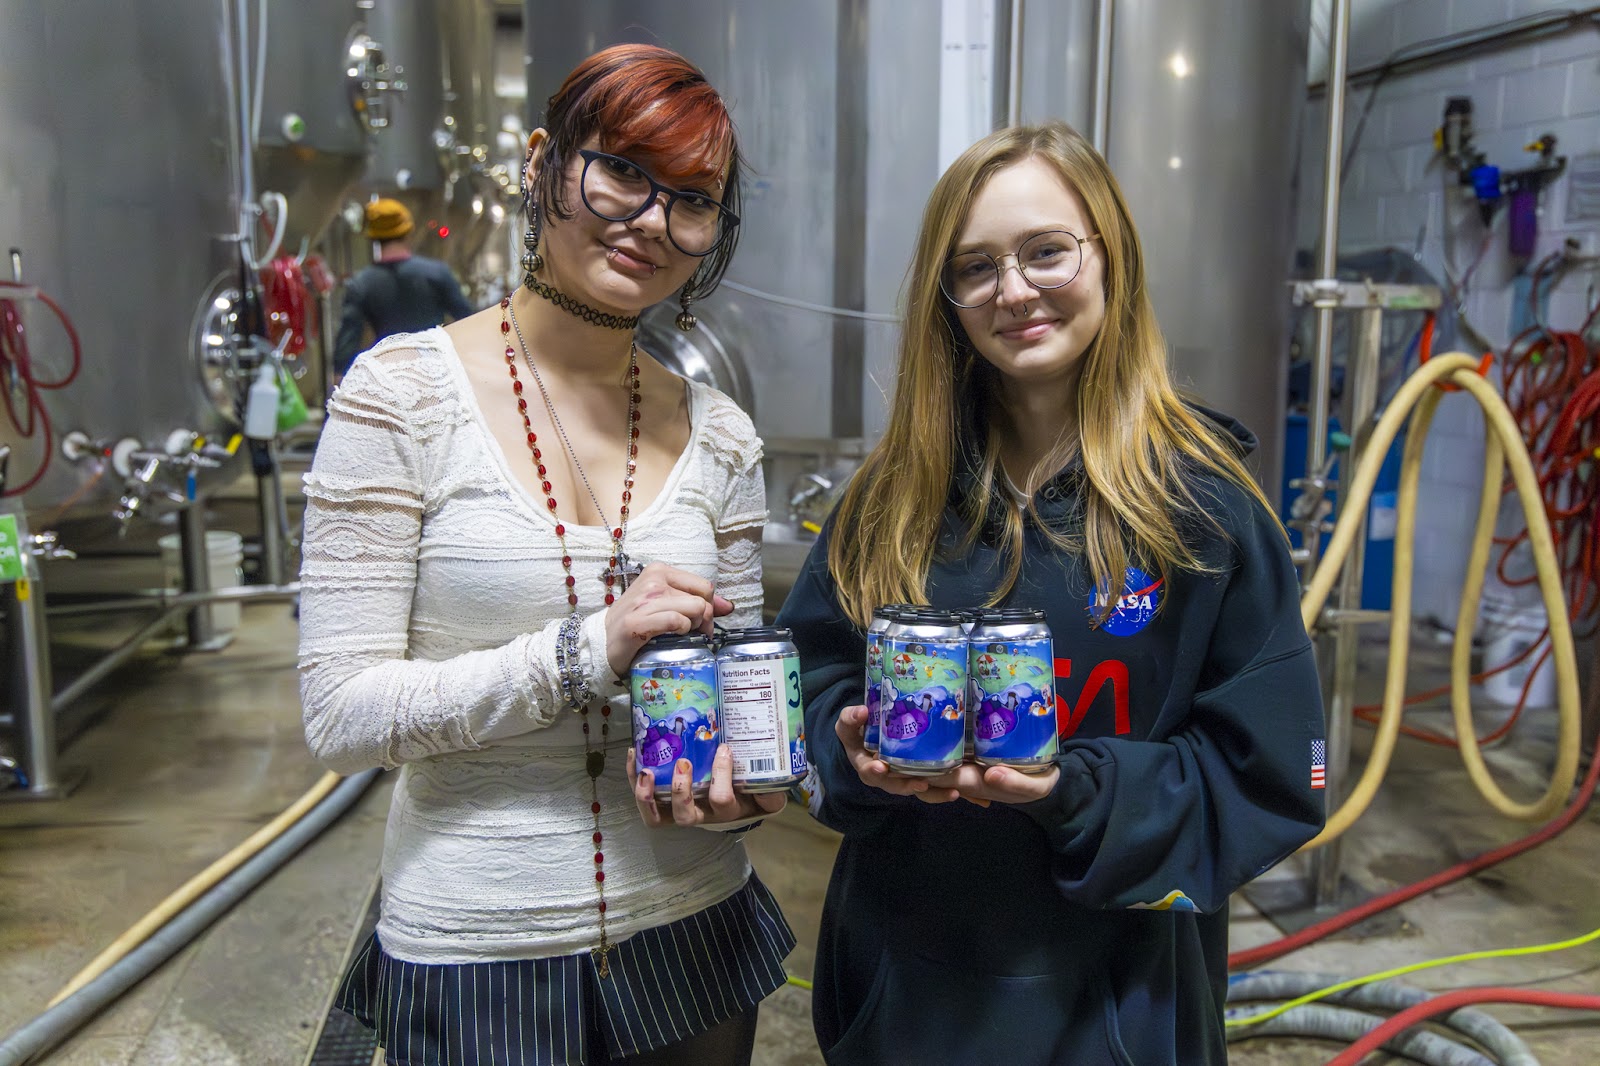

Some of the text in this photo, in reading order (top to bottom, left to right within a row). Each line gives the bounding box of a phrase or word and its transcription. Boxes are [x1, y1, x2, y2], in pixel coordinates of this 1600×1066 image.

[760, 690, 772, 698] 180
[788, 670, 800, 708] 3
[889, 720, 923, 735] 3 SHEEPS
[985, 720, 1010, 735] SHEEPS
[645, 744, 677, 761] 3 SHEEPS
